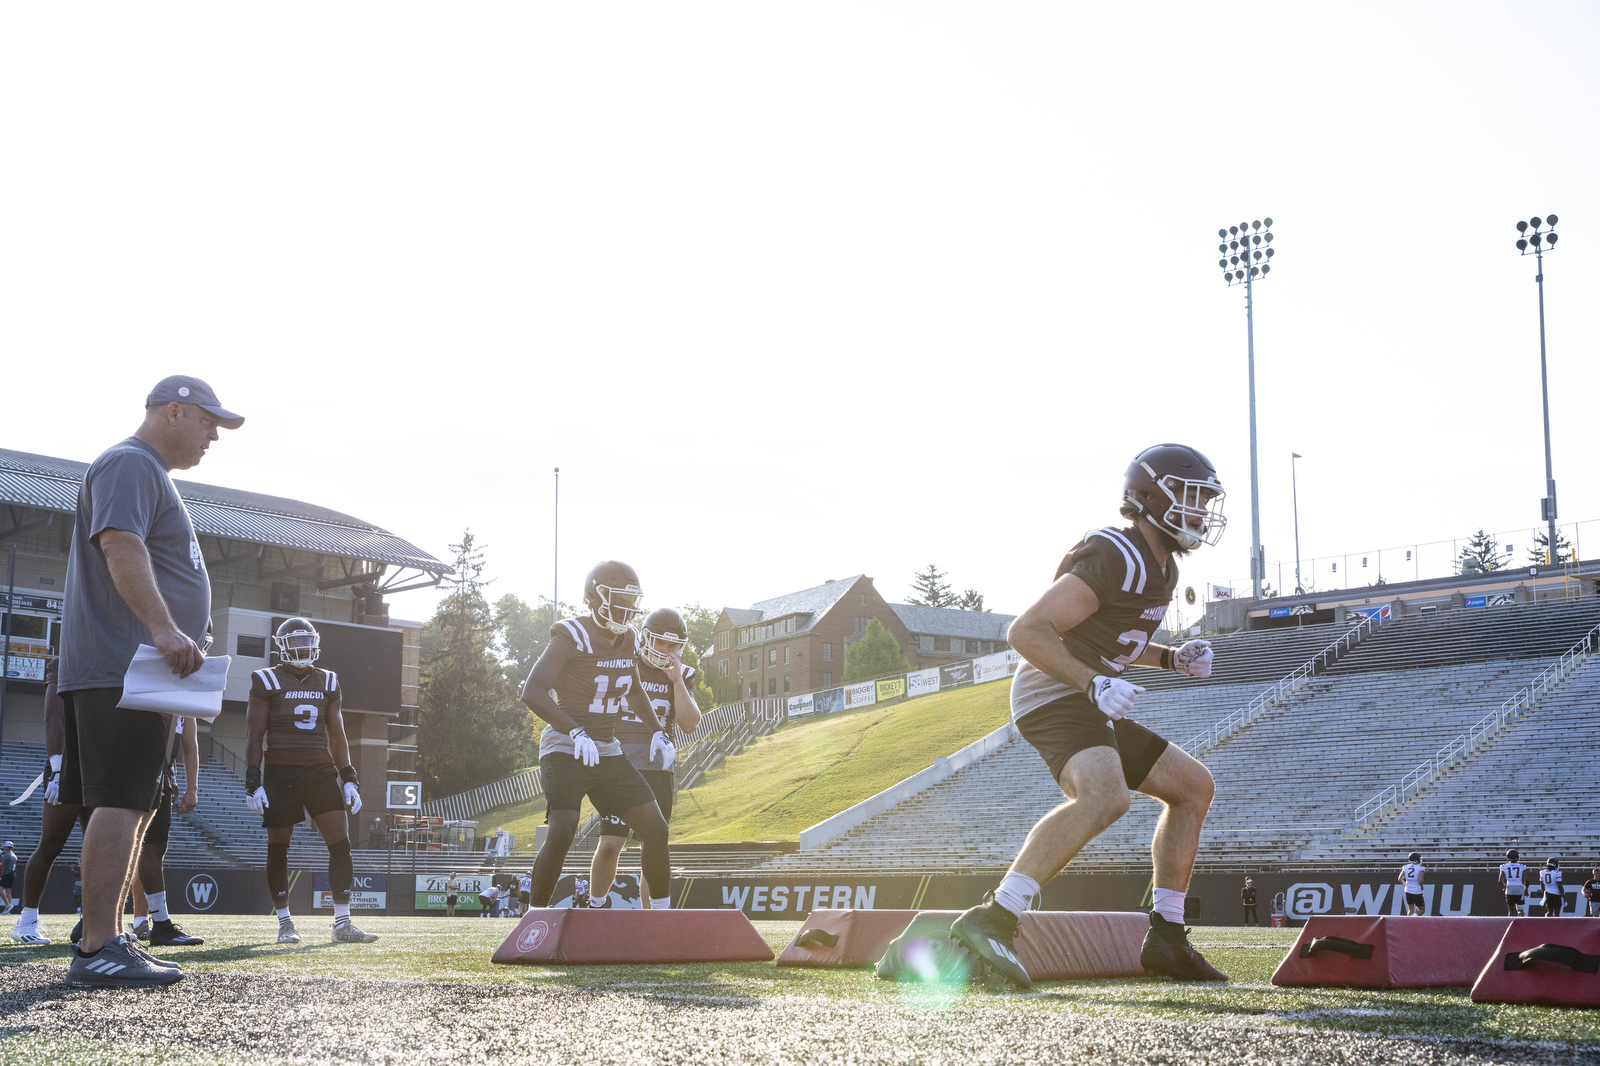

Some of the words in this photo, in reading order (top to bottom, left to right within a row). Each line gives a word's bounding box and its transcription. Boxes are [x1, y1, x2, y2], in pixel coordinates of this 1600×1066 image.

[46, 600, 57, 609] 84
[641, 682, 669, 693] ONCOS
[852, 685, 874, 696] BIGGBY
[852, 695, 875, 705] COFFEE
[294, 704, 319, 730] 3
[1407, 867, 1415, 878] 2
[1507, 867, 1520, 878] 17
[352, 877, 372, 888] NC
[1545, 873, 1552, 884] 0
[192, 883, 213, 903] W
[722, 886, 877, 911] WESTERN
[1286, 883, 1474, 919] @WMU
